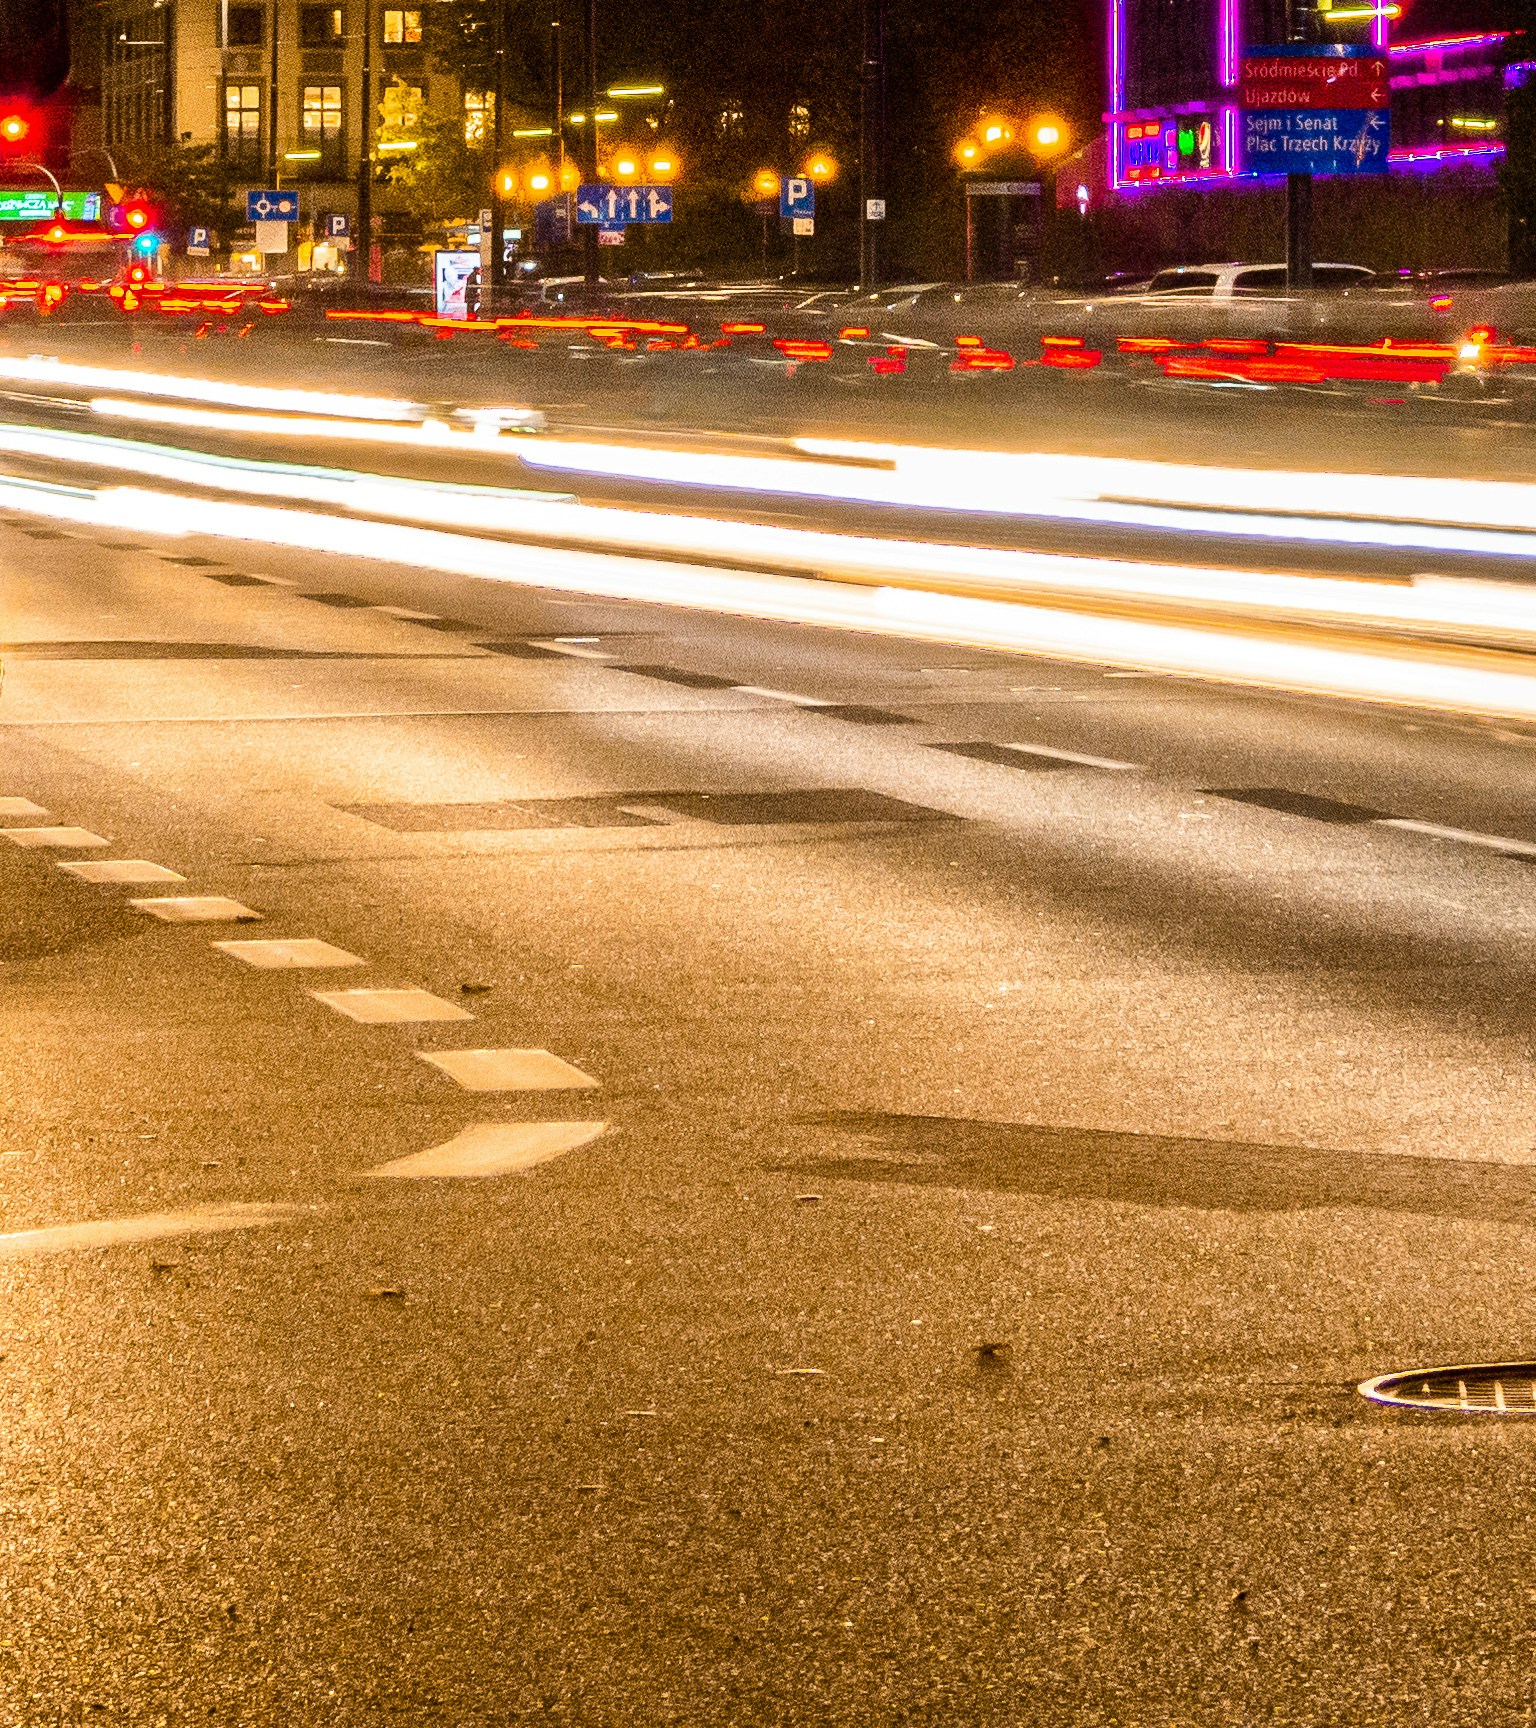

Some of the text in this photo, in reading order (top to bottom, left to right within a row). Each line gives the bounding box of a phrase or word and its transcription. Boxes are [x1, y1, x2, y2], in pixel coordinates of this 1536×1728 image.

[1246, 114, 1338, 135] Sejm i Senat
[1246, 135, 1277, 153] Plac
[1281, 135, 1328, 152] Trzech
[787, 178, 808, 206] P
[332, 216, 345, 235] P
[194, 228, 206, 245] P
